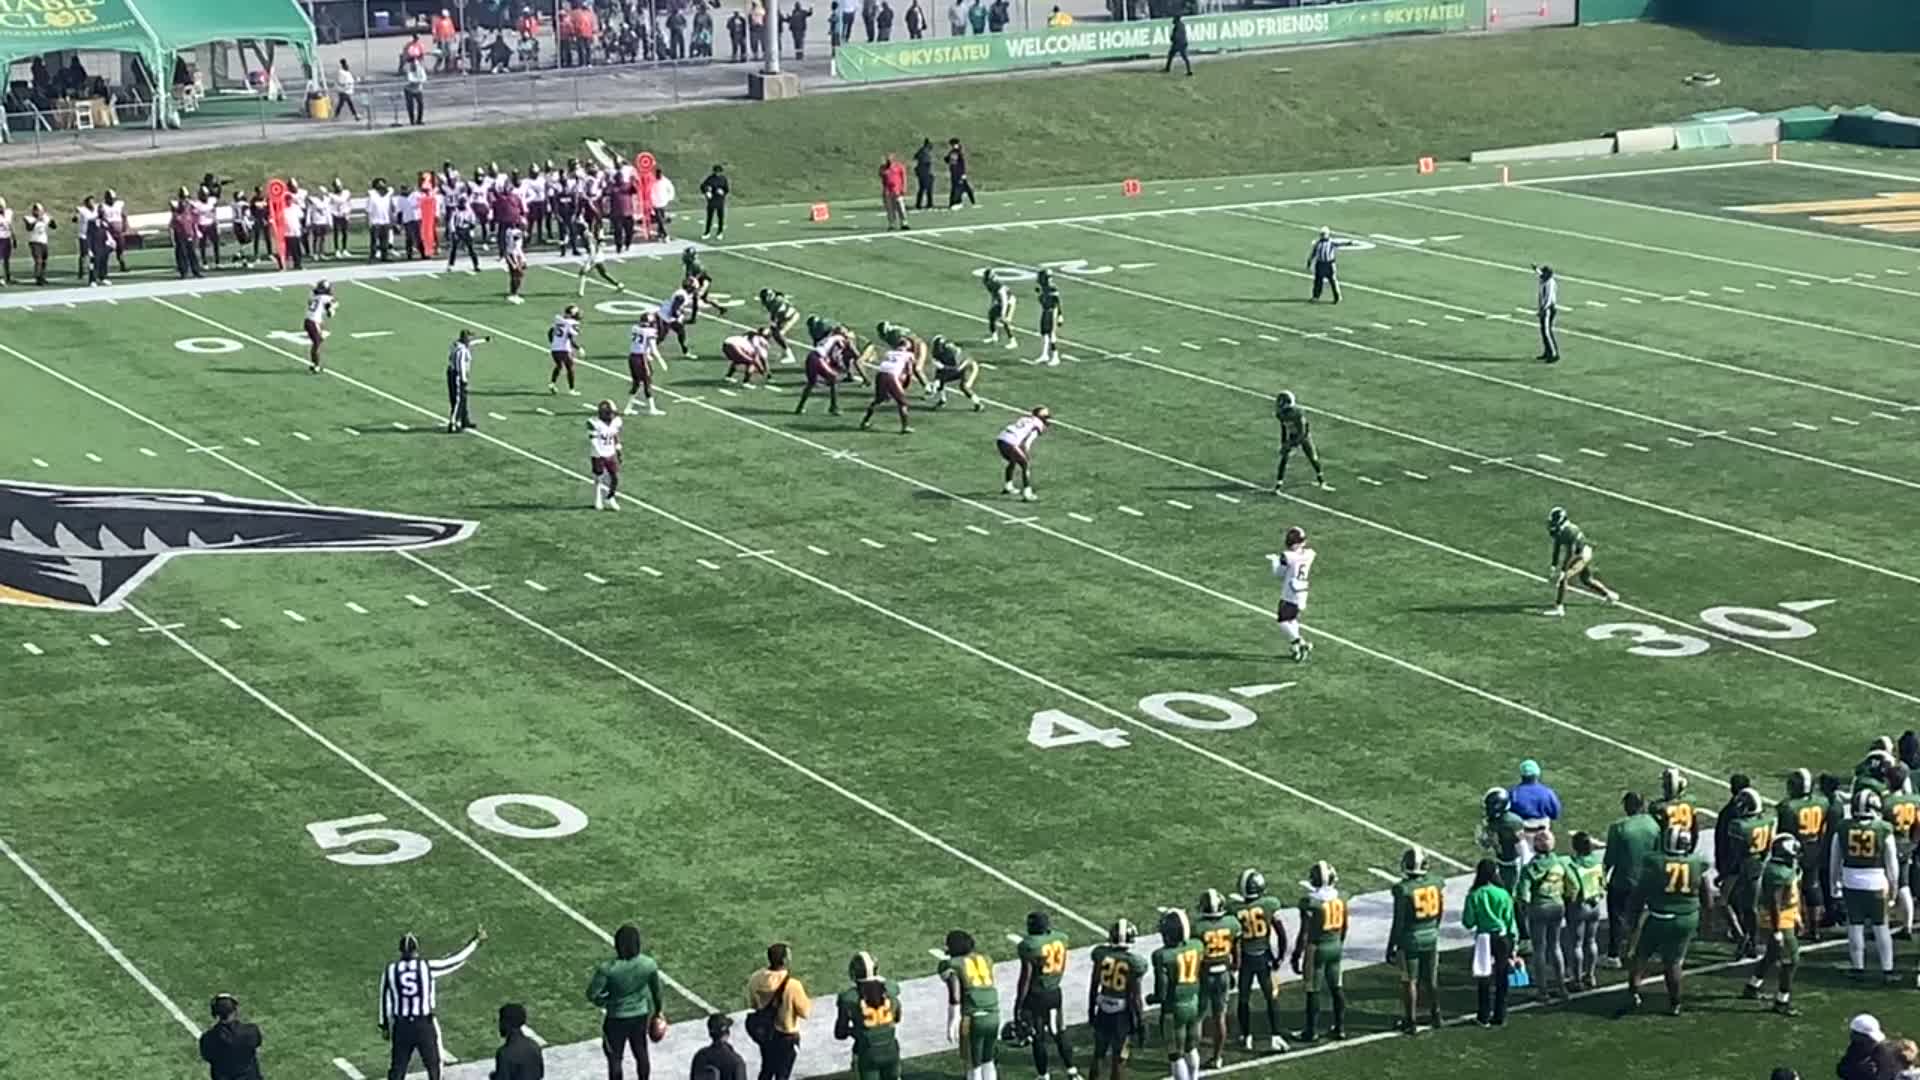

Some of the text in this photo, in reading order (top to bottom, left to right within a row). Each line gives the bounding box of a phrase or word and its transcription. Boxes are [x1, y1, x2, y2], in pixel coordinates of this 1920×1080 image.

[0, 9, 98, 28] CLB
[1006, 13, 1329, 58] WELCOME HOME ALMNI AND FRIENDS!
[899, 43, 991, 67] @KYSTATEU
[1585, 605, 1818, 657] 30
[1026, 690, 1258, 749] 40
[305, 793, 589, 865] 50
[1798, 805, 1823, 835] 90
[1847, 829, 1875, 857] 53
[1664, 862, 1692, 894] 71
[1237, 906, 1268, 940] 36
[1099, 955, 1129, 991] 26
[1176, 950, 1198, 983] 17
[400, 972, 418, 996] S
